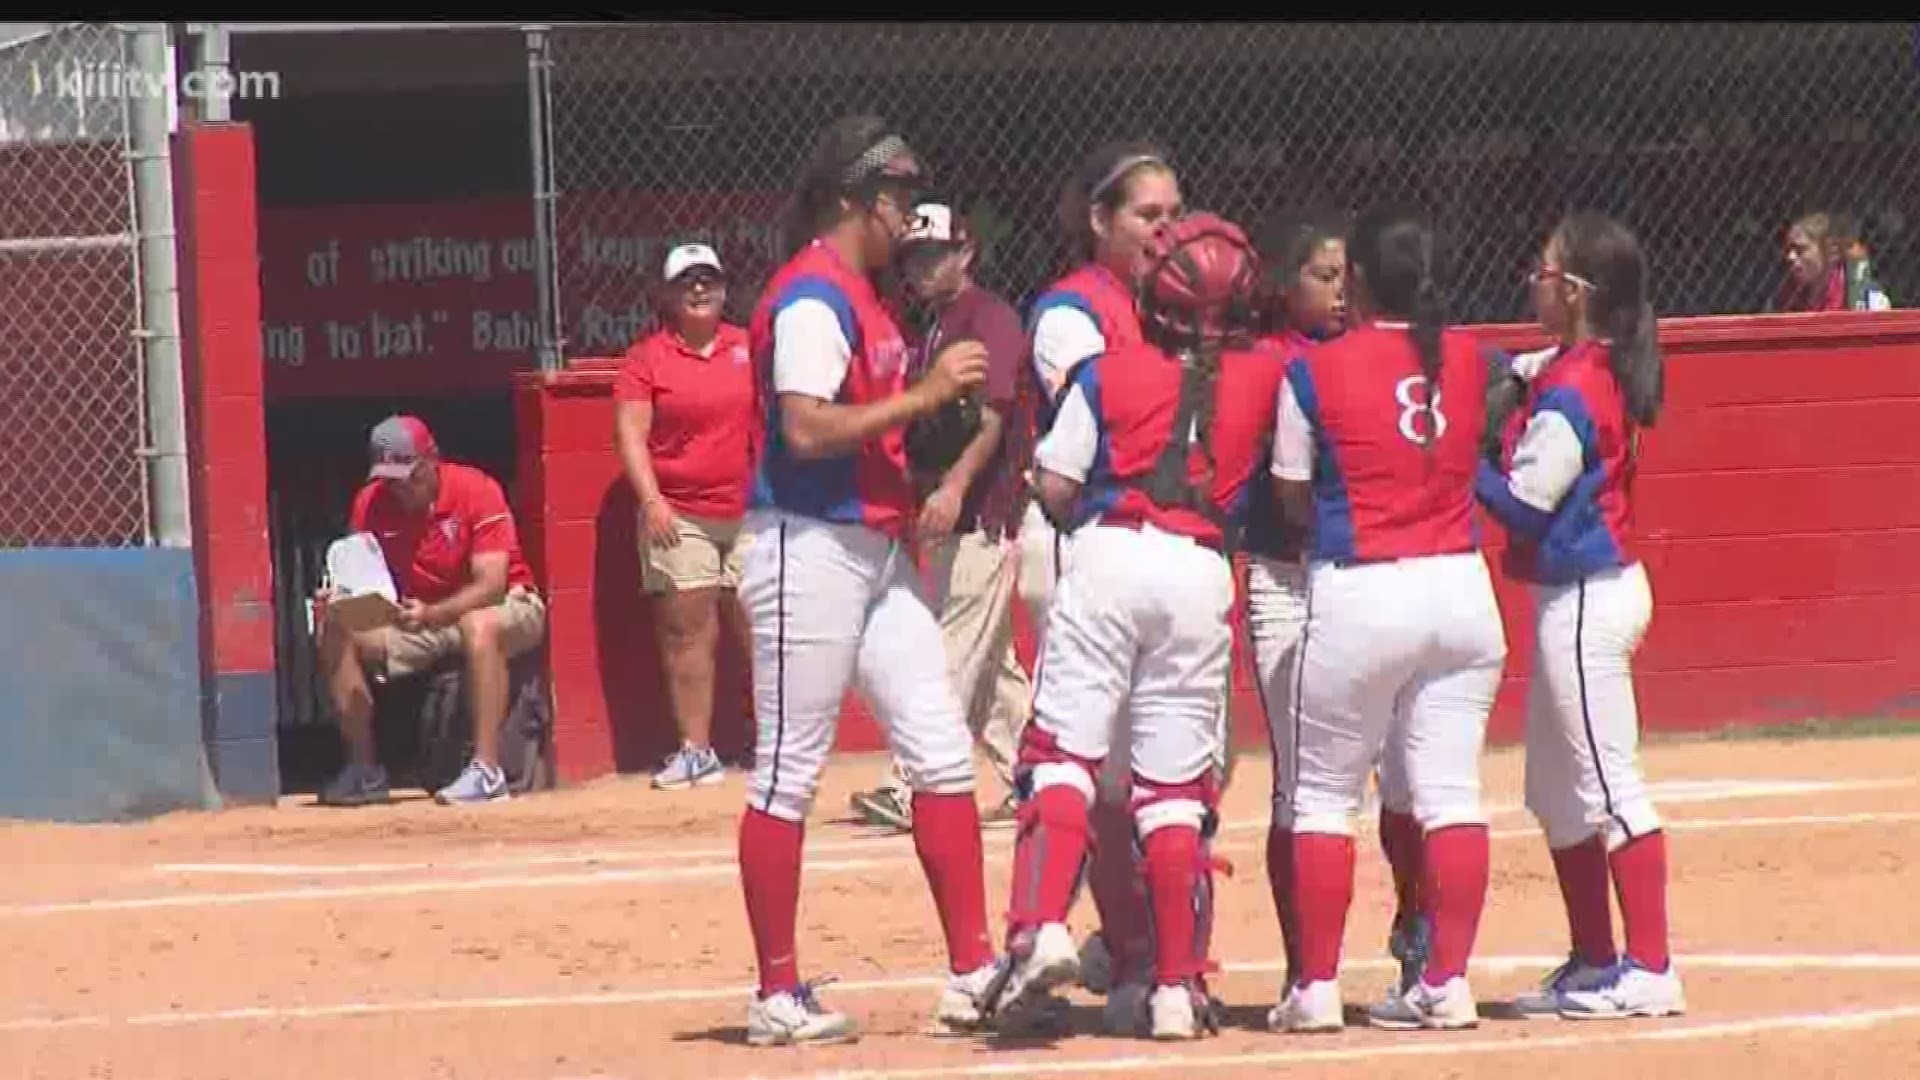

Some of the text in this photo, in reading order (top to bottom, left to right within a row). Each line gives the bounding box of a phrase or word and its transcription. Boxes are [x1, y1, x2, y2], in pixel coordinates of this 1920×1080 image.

[308, 239, 340, 287] of
[370, 238, 492, 284] striking
[503, 237, 542, 272] ou
[261, 320, 304, 366] ng
[323, 321, 360, 358] to
[1395, 375, 1446, 443] 8
